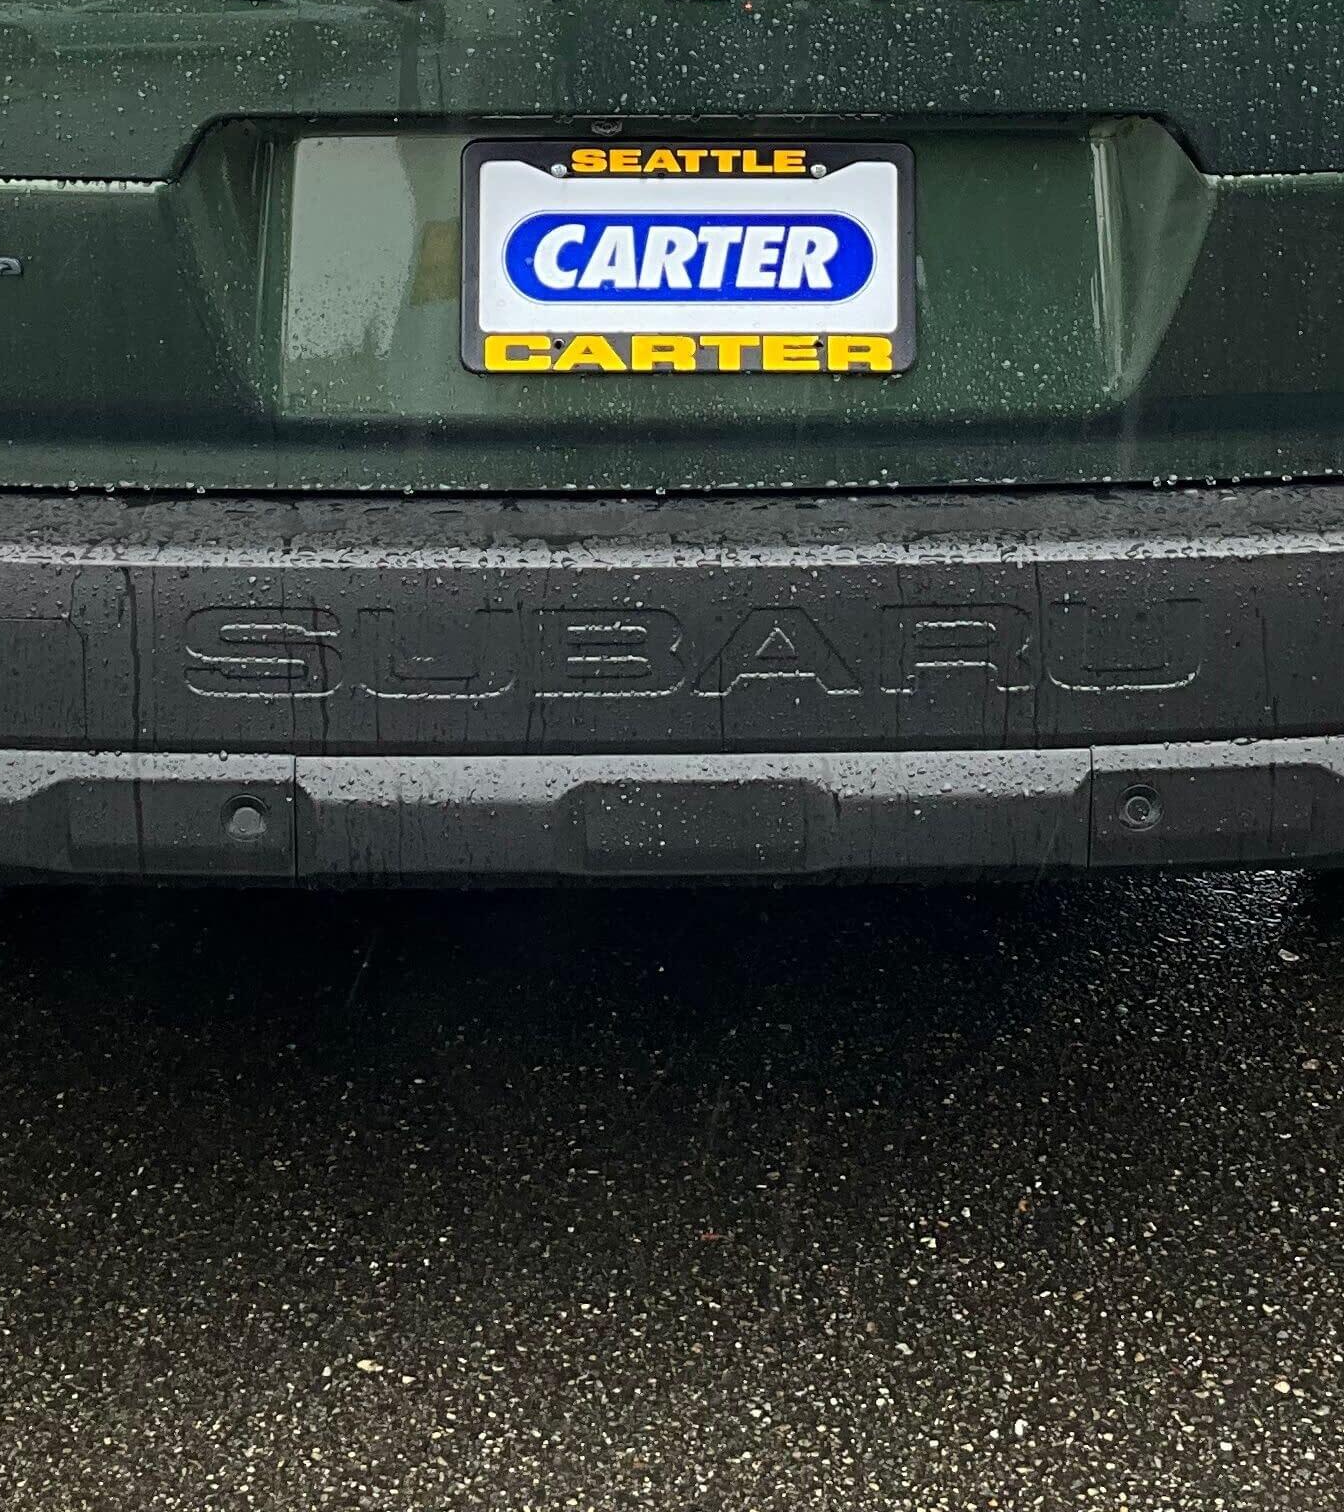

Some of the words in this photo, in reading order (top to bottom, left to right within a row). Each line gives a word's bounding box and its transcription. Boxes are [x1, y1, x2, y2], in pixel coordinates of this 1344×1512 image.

[571, 148, 806, 173] SEATTLE
[533, 223, 839, 289] CARTER
[484, 335, 893, 372] CARTER
[183, 598, 1202, 700] SUBARU
